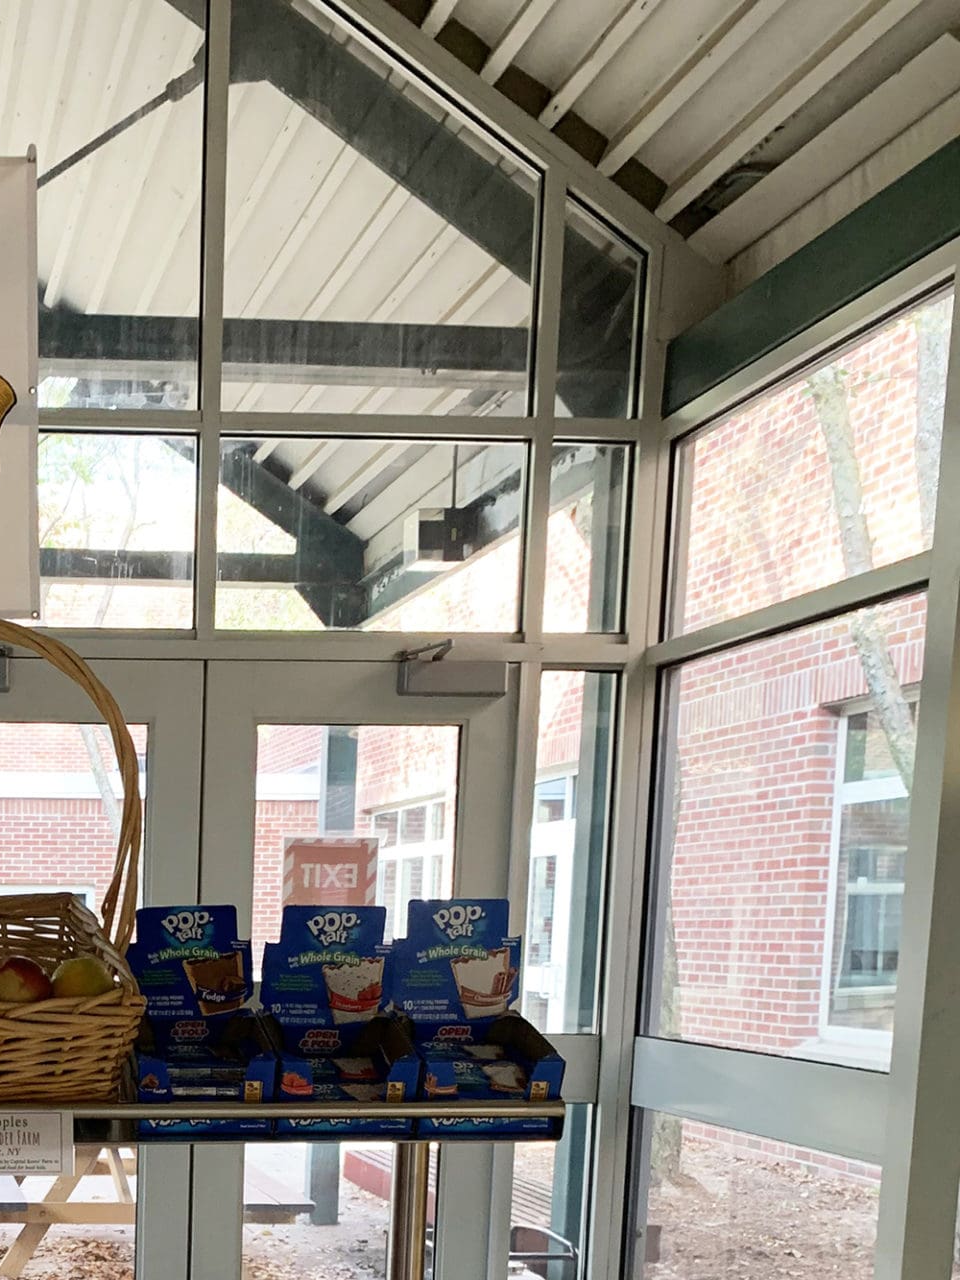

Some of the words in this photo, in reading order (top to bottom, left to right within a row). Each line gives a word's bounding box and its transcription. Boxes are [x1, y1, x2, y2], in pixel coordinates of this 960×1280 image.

[160, 948, 189, 960] Whole
[192, 947, 220, 959] Grain
[428, 946, 459, 958] Whole
[461, 945, 487, 958] Grain
[300, 952, 331, 964] Whole
[333, 951, 360, 965] Grain
[202, 991, 226, 1002] Fudge
[271, 1003, 282, 1013] 10
[403, 1000, 413, 1010] 10
[440, 1027, 469, 1035] OPEN
[17, 1130, 40, 1146] FARM
[7, 1148, 21, 1156] NY
